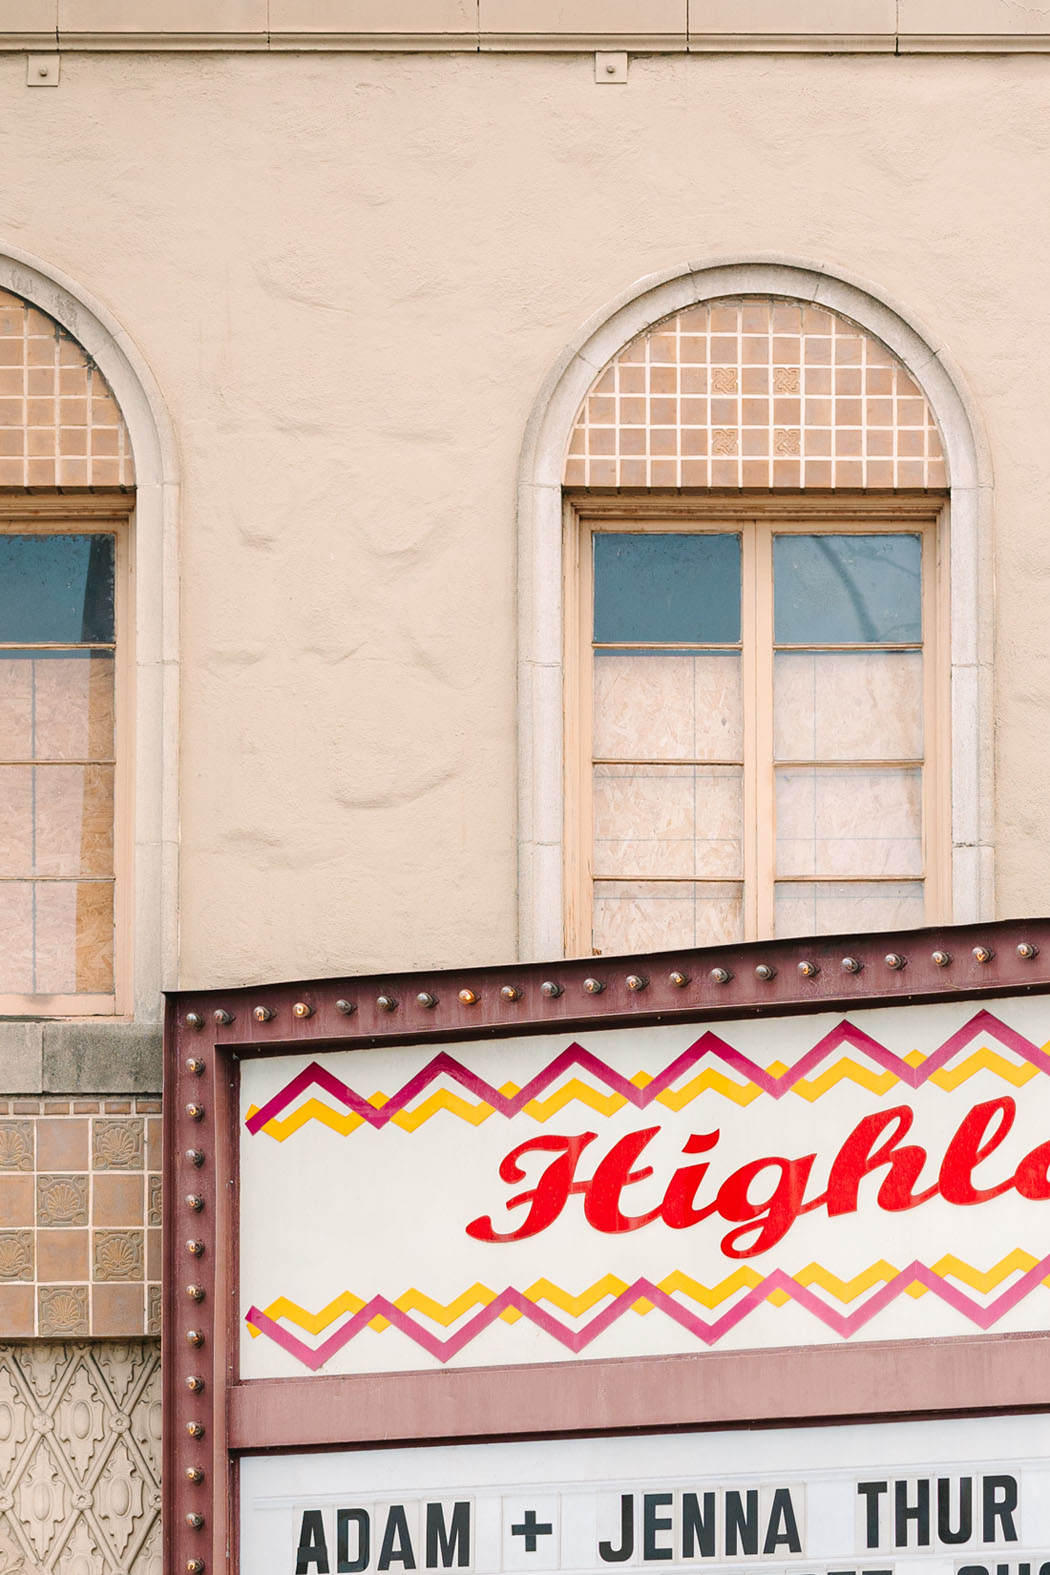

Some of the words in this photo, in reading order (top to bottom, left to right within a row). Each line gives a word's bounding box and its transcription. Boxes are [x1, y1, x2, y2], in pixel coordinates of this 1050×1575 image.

[295, 1501, 471, 1575] ADAM
[511, 1510, 553, 1552] +
[598, 1488, 802, 1563] JENNA
[857, 1475, 1019, 1549] THUR
